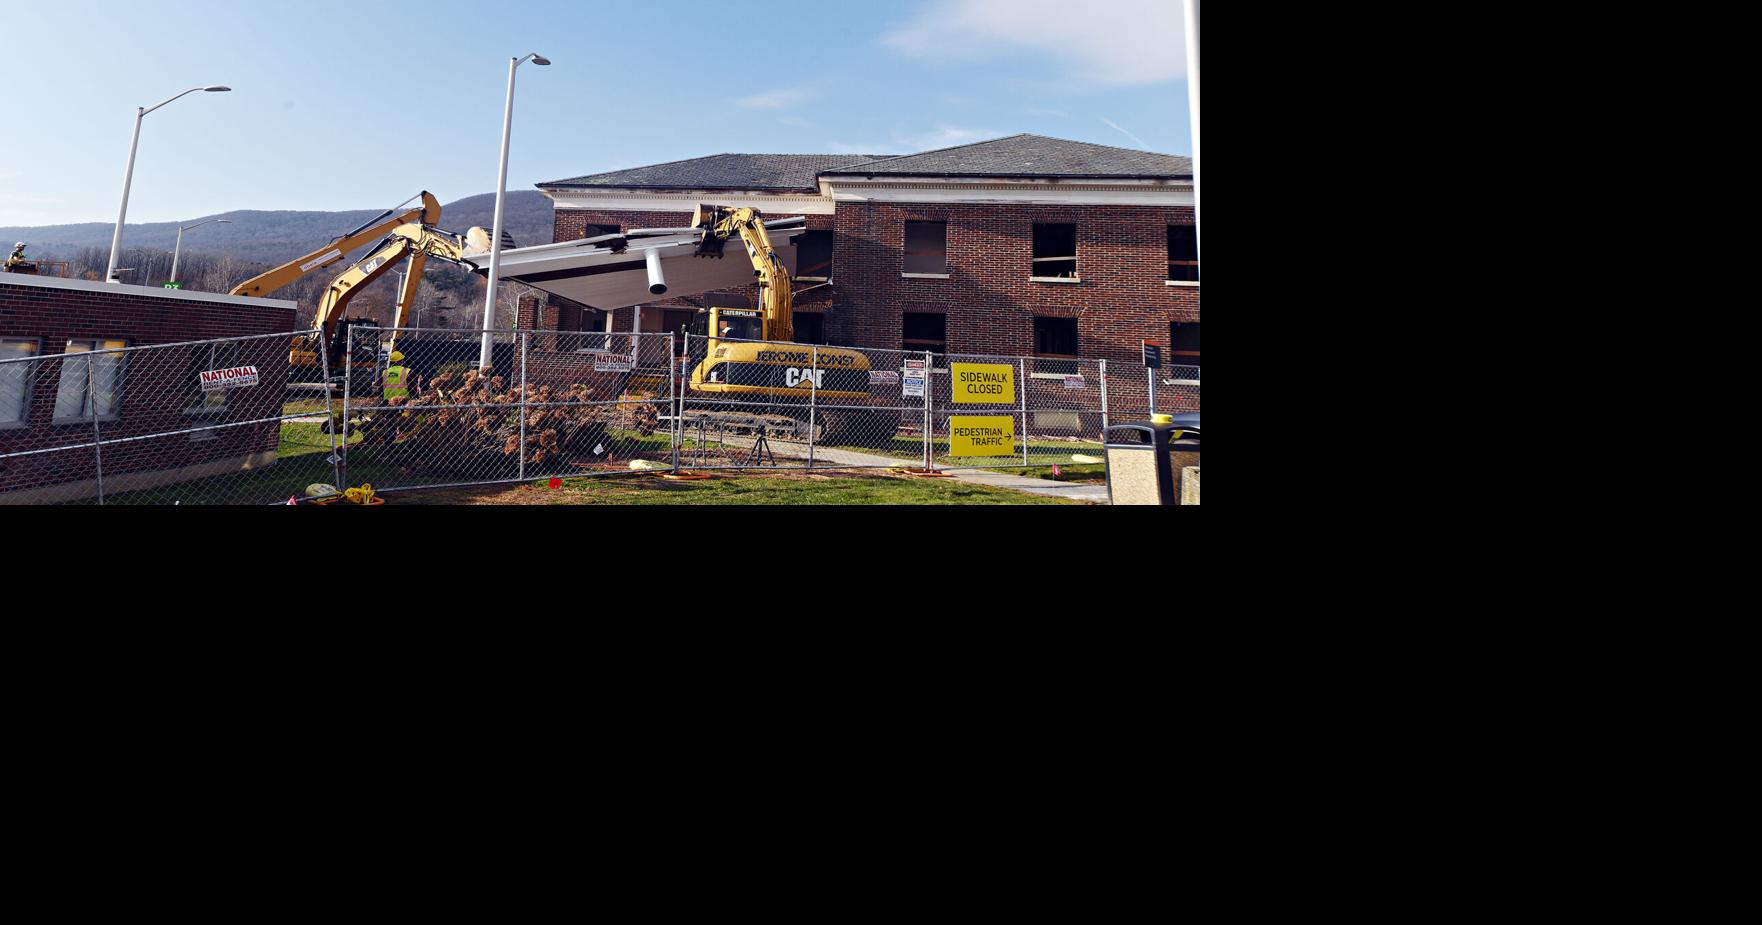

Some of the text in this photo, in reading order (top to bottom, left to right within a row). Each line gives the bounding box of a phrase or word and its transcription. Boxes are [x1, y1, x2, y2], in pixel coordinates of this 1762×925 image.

[596, 355, 630, 363] NATIONAL
[755, 351, 809, 363] JEROME
[201, 366, 257, 382] NATIONAL
[785, 367, 825, 389] CAT
[960, 372, 1008, 383] SIDEWALK
[967, 384, 1003, 394] CLOSED
[954, 428, 1003, 436] PEDESTRIAN
[971, 437, 1003, 446] TRAFFIC
